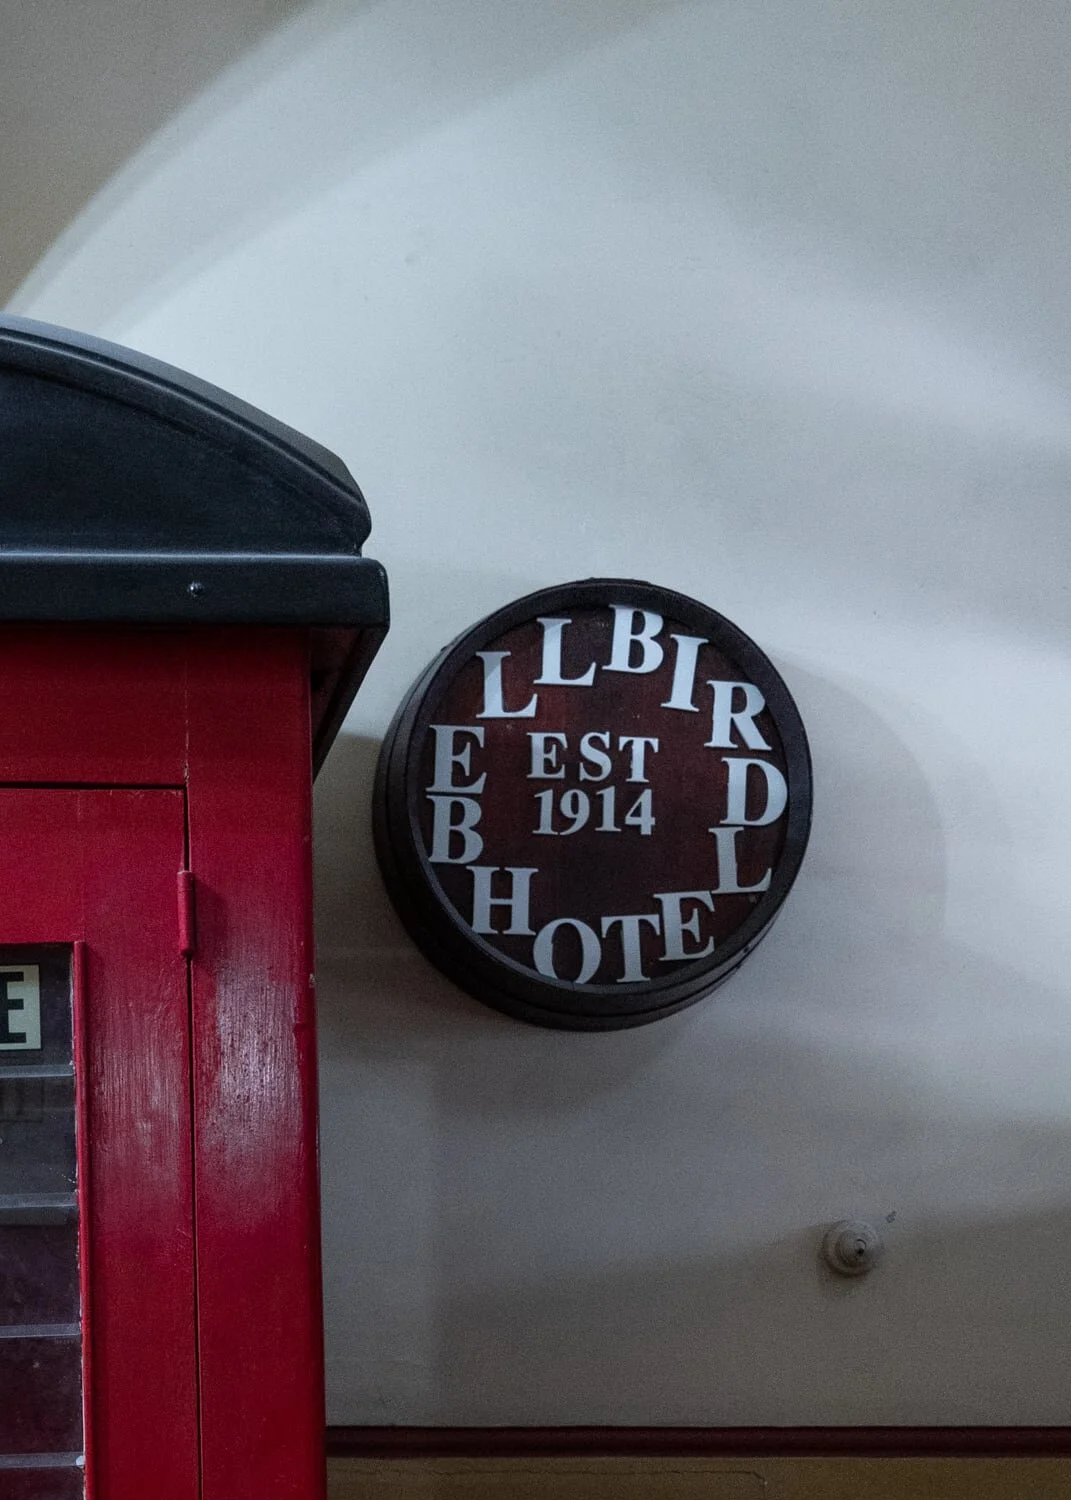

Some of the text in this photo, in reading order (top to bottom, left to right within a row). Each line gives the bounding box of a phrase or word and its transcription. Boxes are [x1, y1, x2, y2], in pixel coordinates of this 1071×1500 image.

[526, 731, 659, 783] EST
[532, 785, 656, 836] 1914
[466, 826, 772, 985] HOTEL
